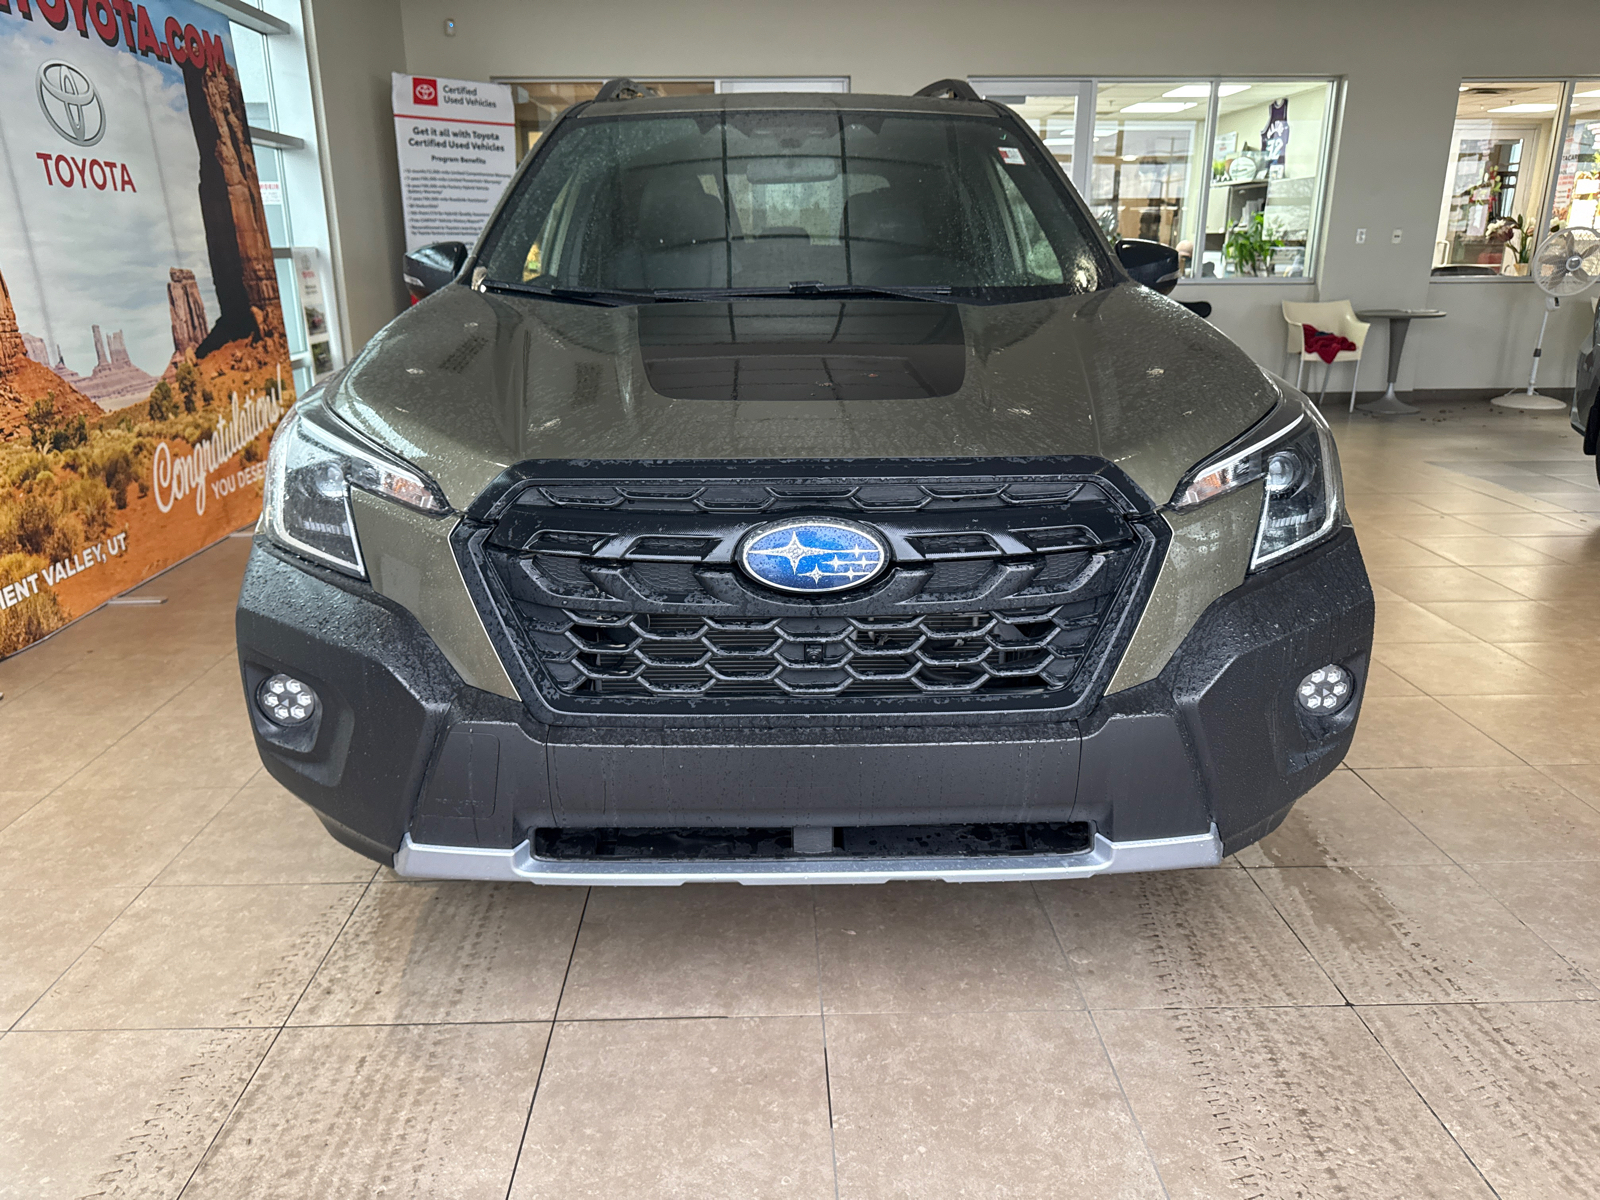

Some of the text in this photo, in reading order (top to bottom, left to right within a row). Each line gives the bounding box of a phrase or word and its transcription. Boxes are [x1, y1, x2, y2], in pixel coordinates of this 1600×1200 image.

[443, 85, 477, 96] Certified
[443, 96, 497, 108] Used Vehicles
[412, 126, 500, 141] Get it all with Toyota
[408, 138, 505, 152] Certified Used Vehicles
[431, 154, 487, 165] Program Benefits
[36, 152, 137, 193] TOYOTA
[153, 363, 285, 517] Congratulations!
[211, 474, 236, 500] YOU
[41, 543, 107, 587] VALLEY,
[107, 532, 126, 556] UT
